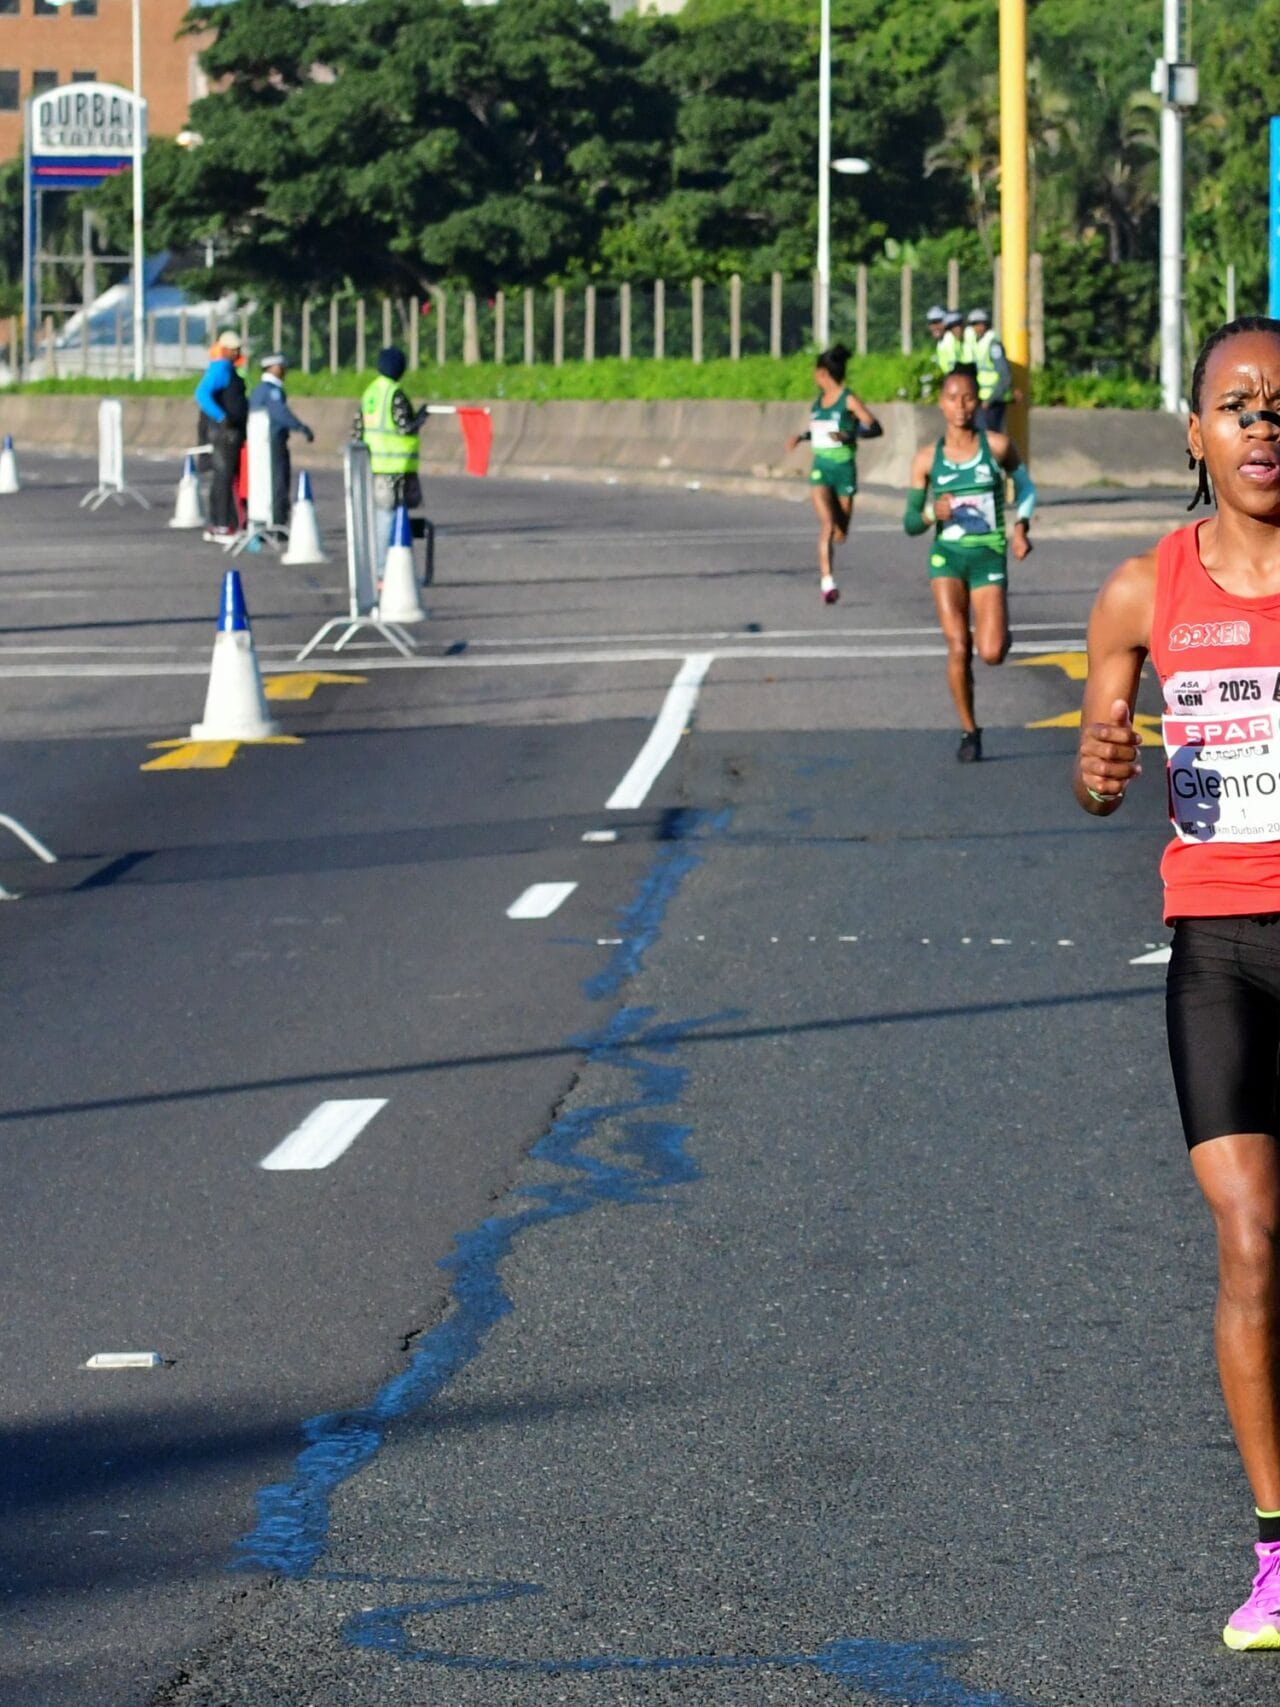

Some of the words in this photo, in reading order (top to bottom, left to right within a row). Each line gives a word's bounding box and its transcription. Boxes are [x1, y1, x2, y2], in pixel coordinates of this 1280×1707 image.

[1168, 620, 1250, 651] BOXER
[1180, 681, 1200, 689] ASA
[1219, 679, 1262, 702] 2025
[1177, 693, 1203, 706] AGN
[1184, 718, 1271, 742] SPAR
[1231, 825, 1265, 835] Durban
